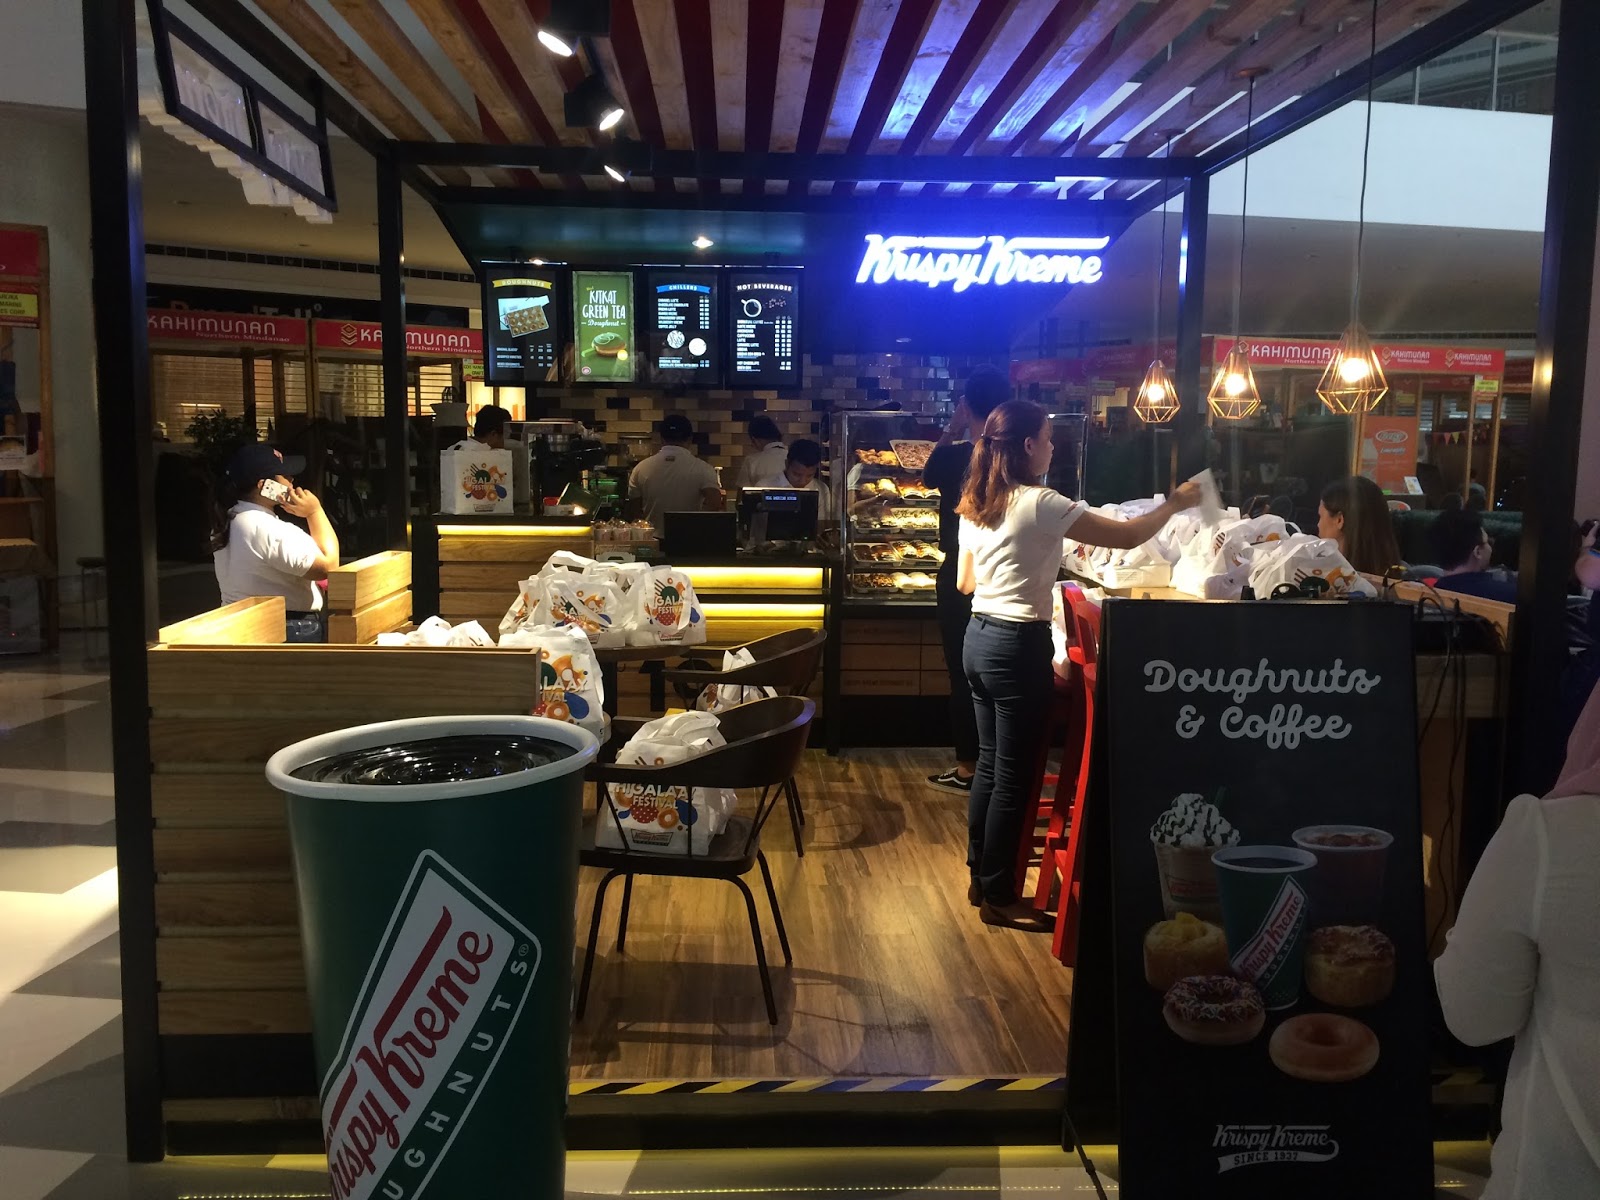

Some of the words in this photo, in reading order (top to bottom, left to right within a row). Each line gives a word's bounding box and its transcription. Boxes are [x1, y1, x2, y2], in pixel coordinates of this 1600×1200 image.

[855, 234, 986, 293] Krispy
[975, 235, 1110, 286] Kreme
[502, 279, 545, 287] DOUGHNUTS
[589, 290, 617, 304] KITKAT
[582, 304, 609, 319] GREEN
[611, 304, 626, 319] TEA
[146, 315, 276, 336] KAHIMUNAN
[360, 328, 470, 348] KAMUNAN
[1143, 658, 1381, 703] Doughnuts
[1175, 705, 1205, 738] &
[1220, 704, 1352, 749] Coffee
[633, 795, 679, 810] FESTIVAL
[355, 906, 494, 1114] Kreme
[1212, 1124, 1273, 1151] Krispy
[1270, 1124, 1331, 1148] Kreme
[1234, 1152, 1269, 1165] SINCE
[1274, 1152, 1299, 1161] 1937
